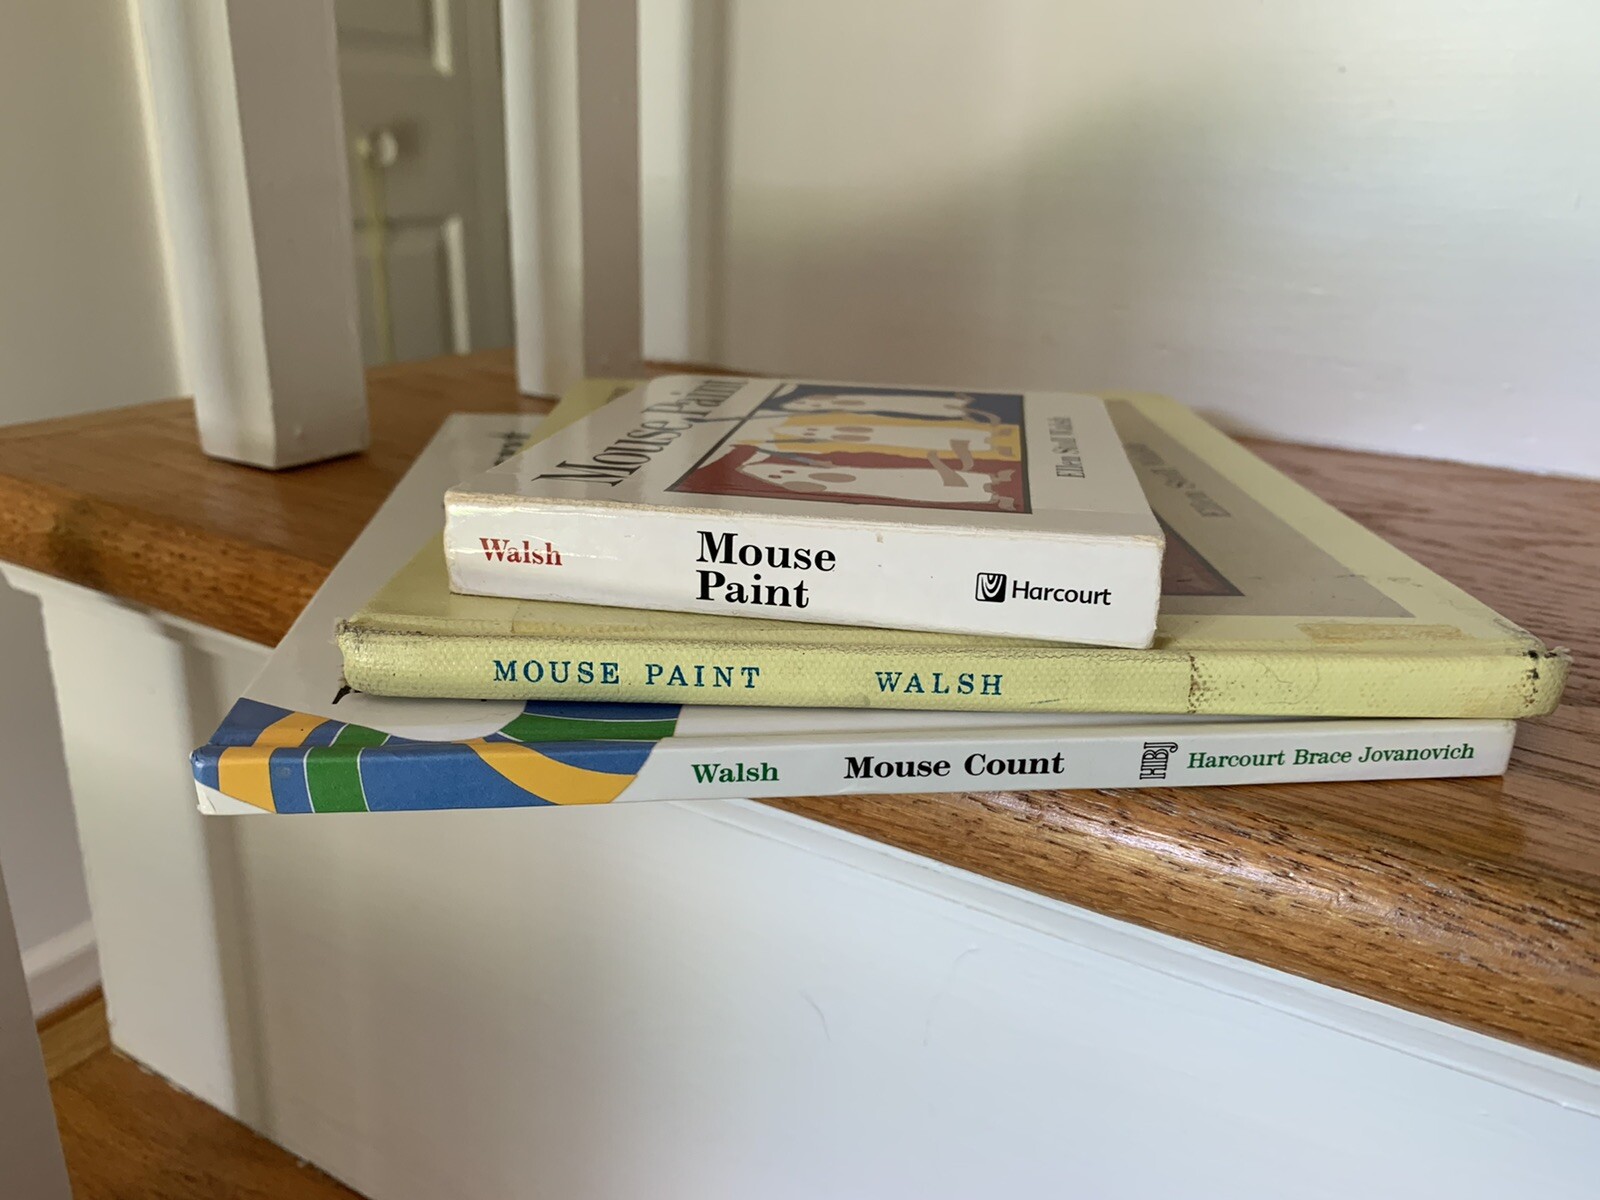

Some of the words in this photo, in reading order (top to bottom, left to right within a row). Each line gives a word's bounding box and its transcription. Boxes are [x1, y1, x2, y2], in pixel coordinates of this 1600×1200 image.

[480, 537, 563, 566] Walsh
[696, 530, 836, 573] Mouse
[695, 570, 810, 609] Paint
[1011, 580, 1112, 606] Harcourt
[493, 659, 620, 685] MOUSE
[645, 664, 762, 689] PAINT
[875, 671, 1004, 697] WALSH
[843, 756, 952, 780] Mouse
[963, 752, 1065, 776] Count
[1187, 749, 1286, 769] Harcourt
[1293, 748, 1352, 765] Brace
[1358, 743, 1475, 764] Jovanovich
[691, 762, 780, 784] Walsh
